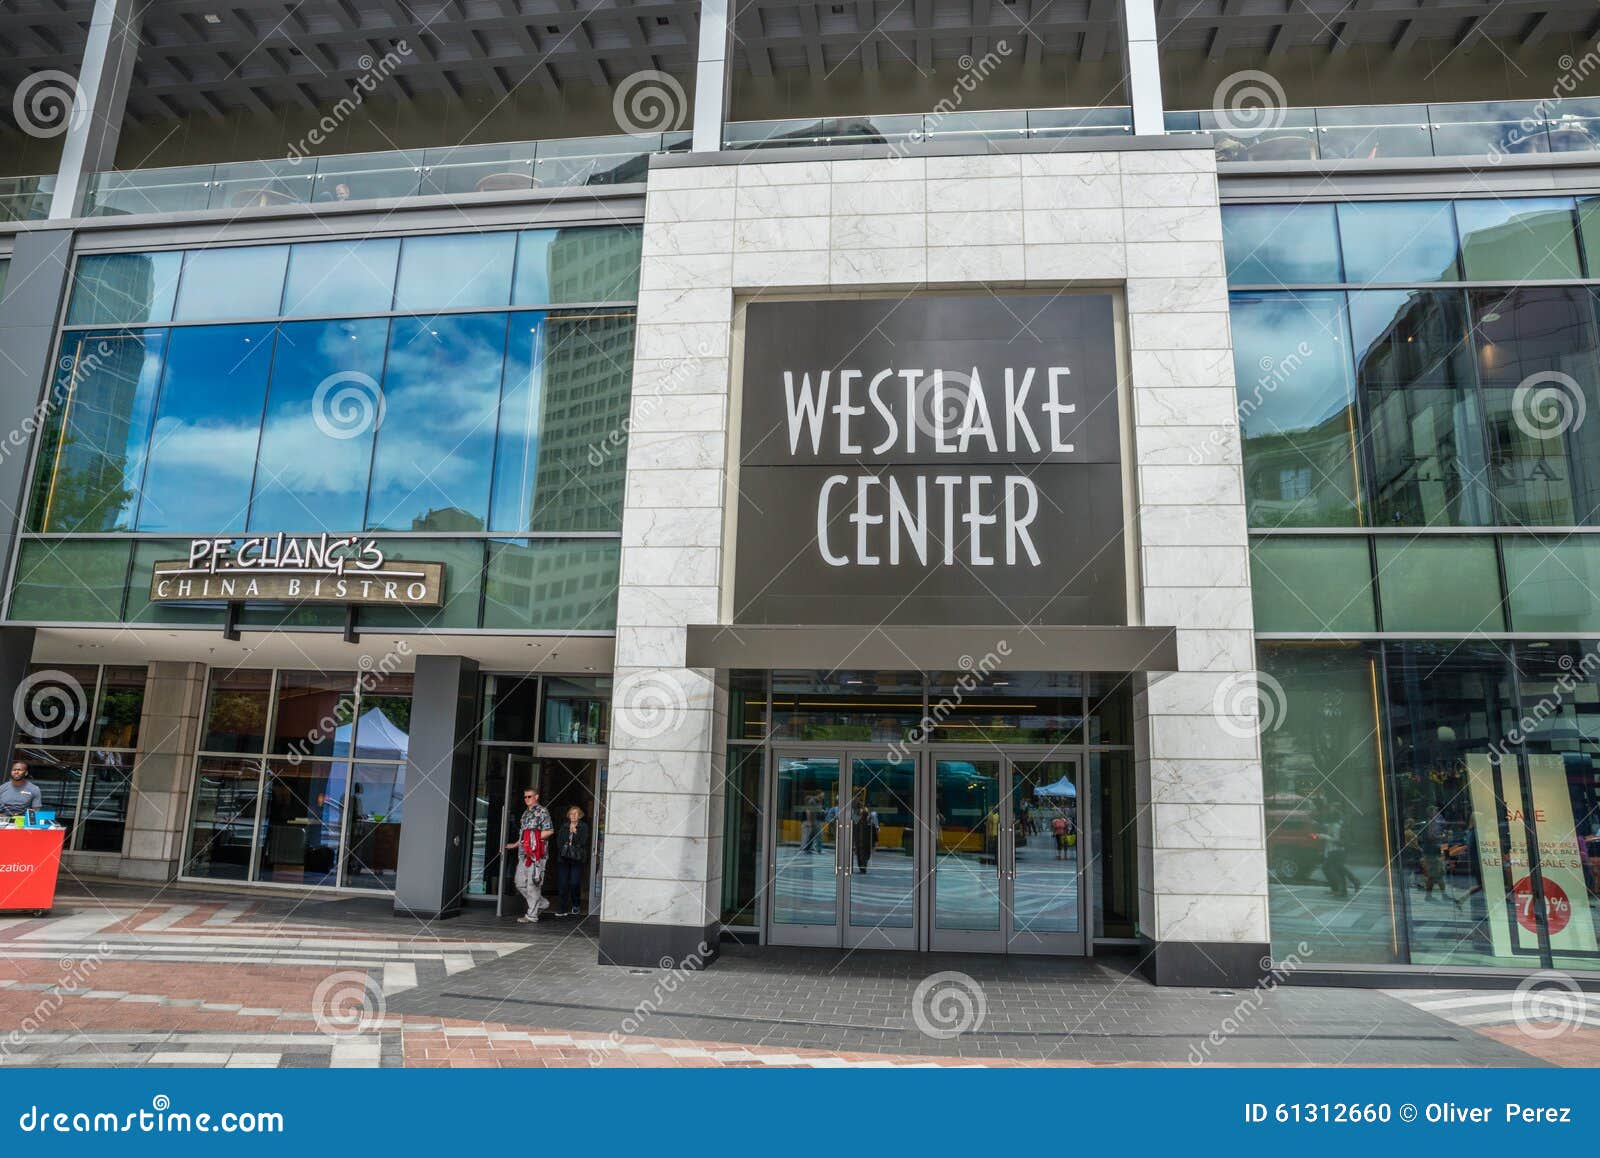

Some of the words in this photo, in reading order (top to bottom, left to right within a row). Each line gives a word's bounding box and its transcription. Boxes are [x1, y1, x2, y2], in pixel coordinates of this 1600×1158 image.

[783, 366, 1076, 456] WESTLAKE
[817, 474, 1042, 567] CENTER
[157, 578, 259, 598] CHINA
[288, 578, 427, 601] BISTRO
[1505, 809, 1546, 823] SAE
